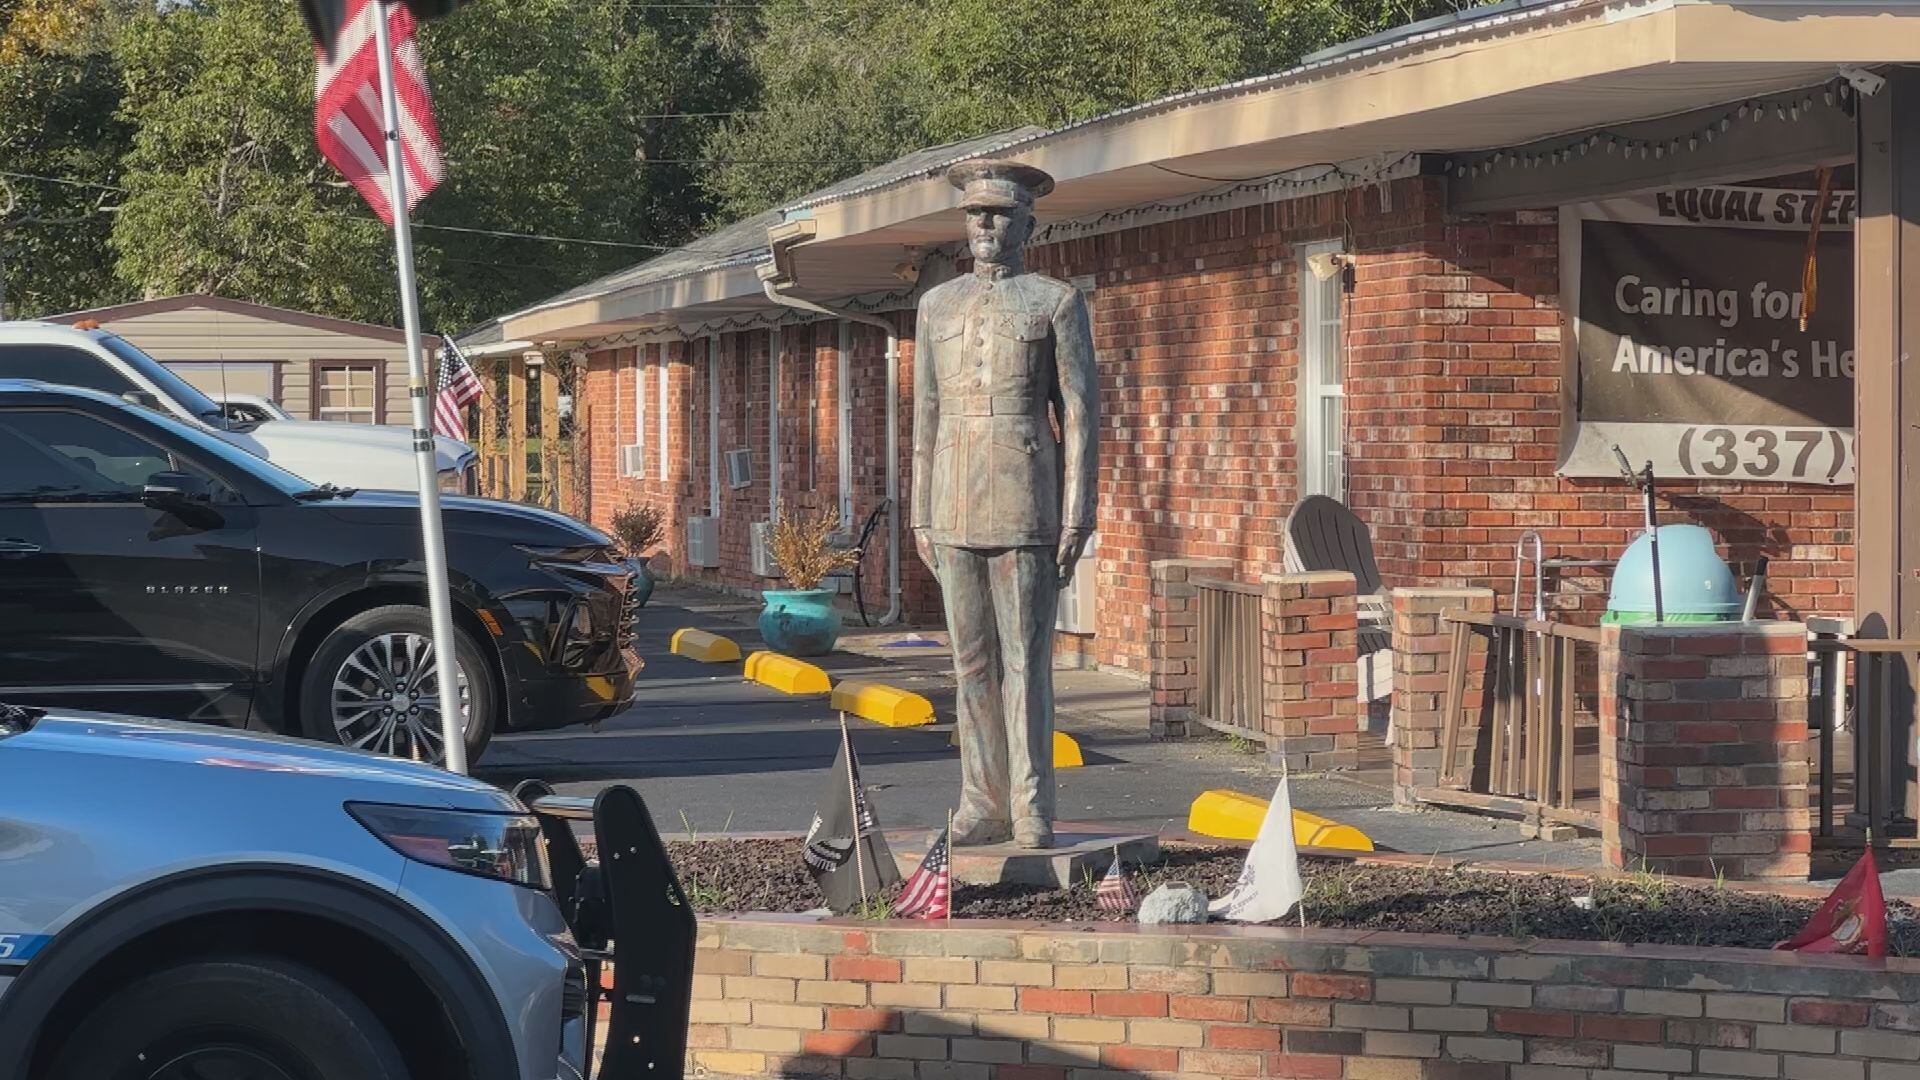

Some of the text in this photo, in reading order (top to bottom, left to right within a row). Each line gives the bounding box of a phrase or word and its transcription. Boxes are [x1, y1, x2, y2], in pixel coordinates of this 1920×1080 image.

[1656, 187, 1765, 223] EQUAL
[1615, 275, 1807, 328] Caring for
[1611, 335, 1855, 378] America's He
[1678, 428, 1855, 478] (337)
[146, 586, 228, 594] BLAZER
